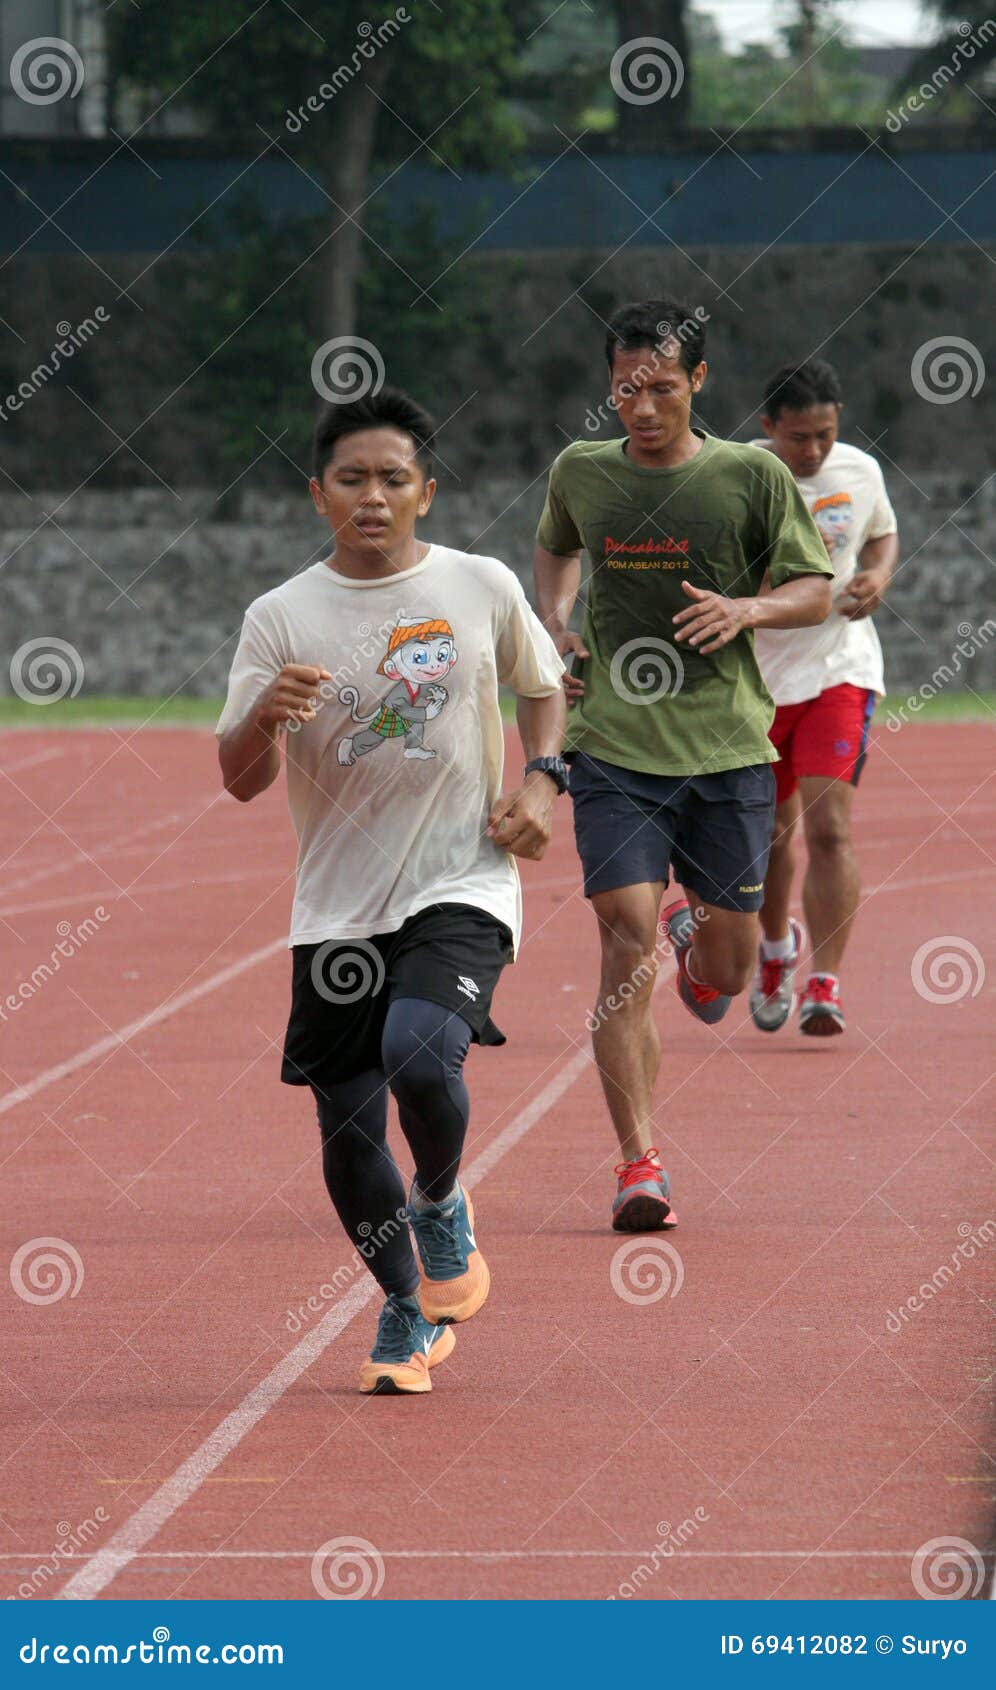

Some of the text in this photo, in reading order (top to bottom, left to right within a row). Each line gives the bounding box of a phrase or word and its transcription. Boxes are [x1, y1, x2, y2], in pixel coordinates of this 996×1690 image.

[607, 561, 689, 570] POM ASEAN 2012
